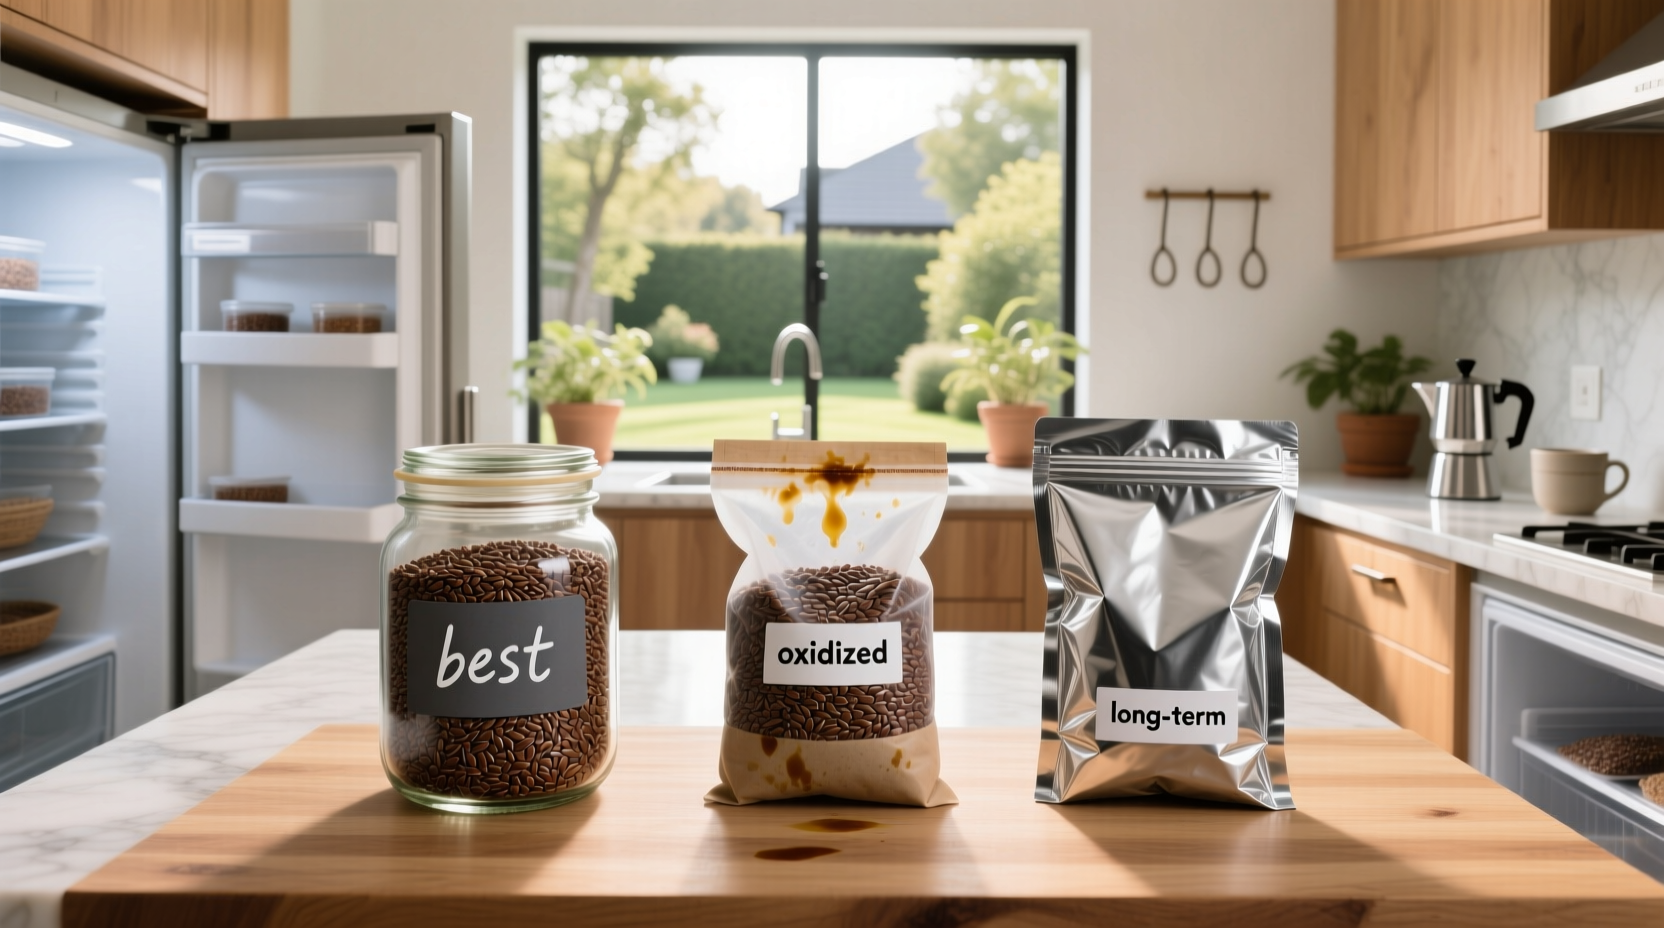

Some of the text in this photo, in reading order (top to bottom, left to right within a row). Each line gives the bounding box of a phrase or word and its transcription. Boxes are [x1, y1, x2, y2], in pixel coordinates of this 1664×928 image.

[436, 623, 554, 688] best
[777, 639, 887, 665] oxidized
[1111, 700, 1226, 731] long-term
